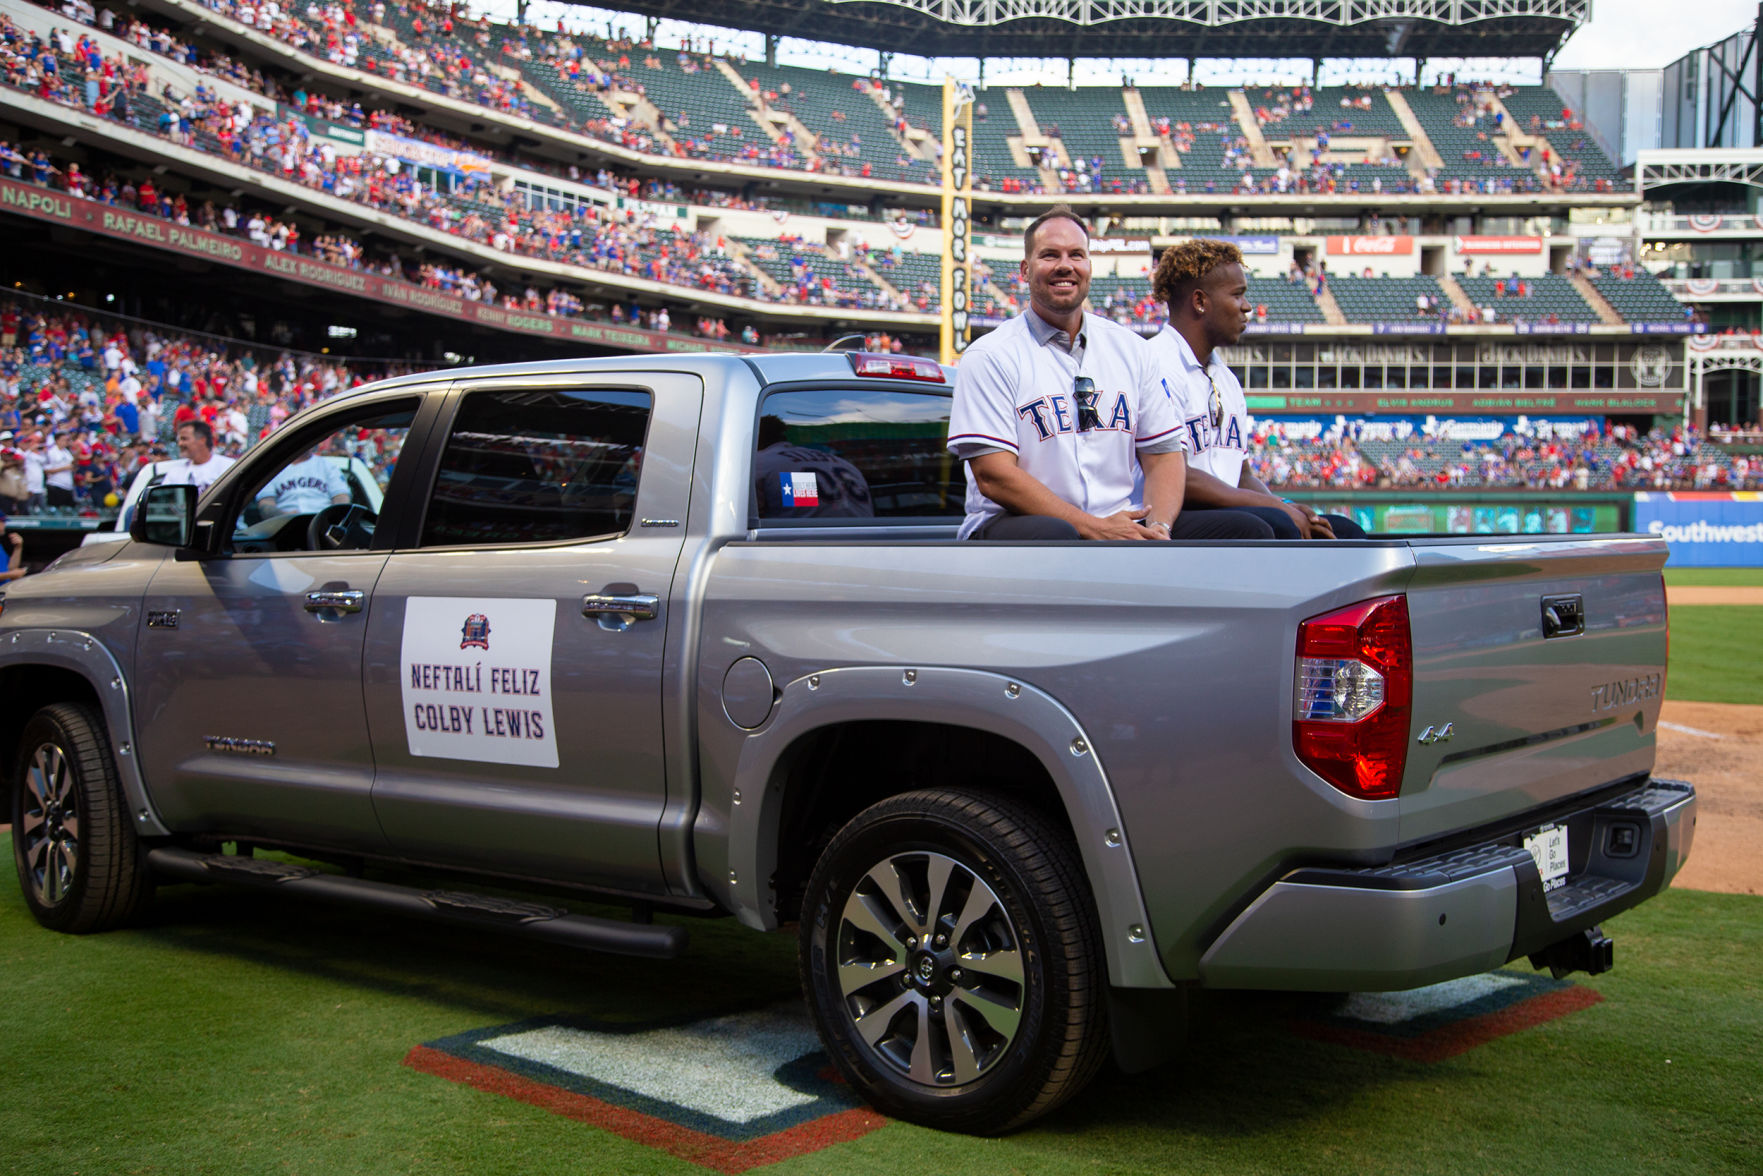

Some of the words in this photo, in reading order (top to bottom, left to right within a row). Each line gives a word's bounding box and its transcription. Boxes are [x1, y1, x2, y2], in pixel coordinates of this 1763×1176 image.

[952, 127, 967, 191] EAT
[952, 196, 967, 263] MOR
[2, 186, 71, 218] NAPOLI
[104, 212, 165, 242] RAFAEL
[169, 229, 242, 261] PALMEIRO
[264, 257, 297, 274] ALEX
[300, 263, 365, 292] RODRIGUEZ
[507, 315, 553, 332] ROGERS
[572, 325, 601, 338] MARK
[951, 267, 968, 353] FOWL
[1016, 390, 1136, 442] TEXA
[1648, 520, 1763, 543] Southwest
[411, 661, 481, 693] NEFTALÍ
[491, 667, 541, 696] FELIZ
[415, 703, 473, 735] COLBY
[482, 707, 544, 740] LEWIS
